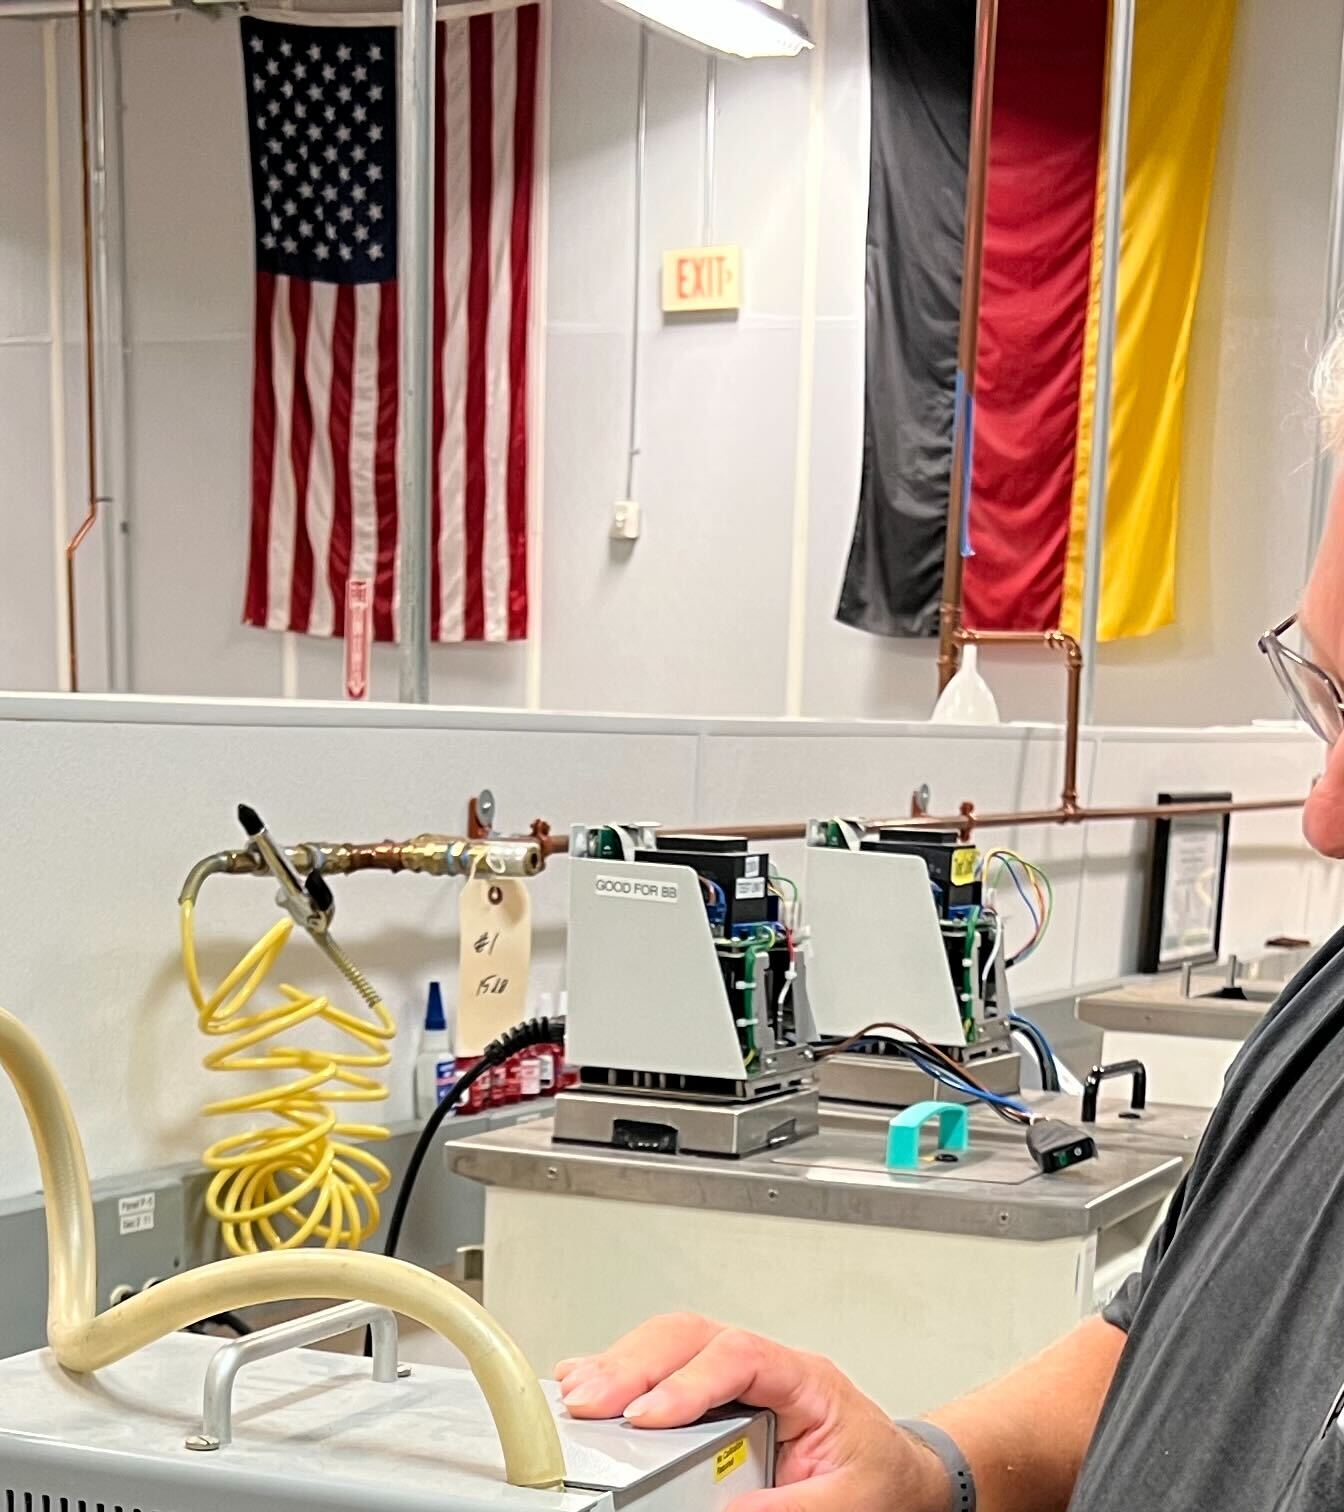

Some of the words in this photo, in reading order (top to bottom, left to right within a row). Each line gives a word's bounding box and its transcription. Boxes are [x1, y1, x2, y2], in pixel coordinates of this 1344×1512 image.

[676, 255, 727, 300] EXIT
[596, 878, 632, 894] GOOD
[634, 883, 659, 897] FOR
